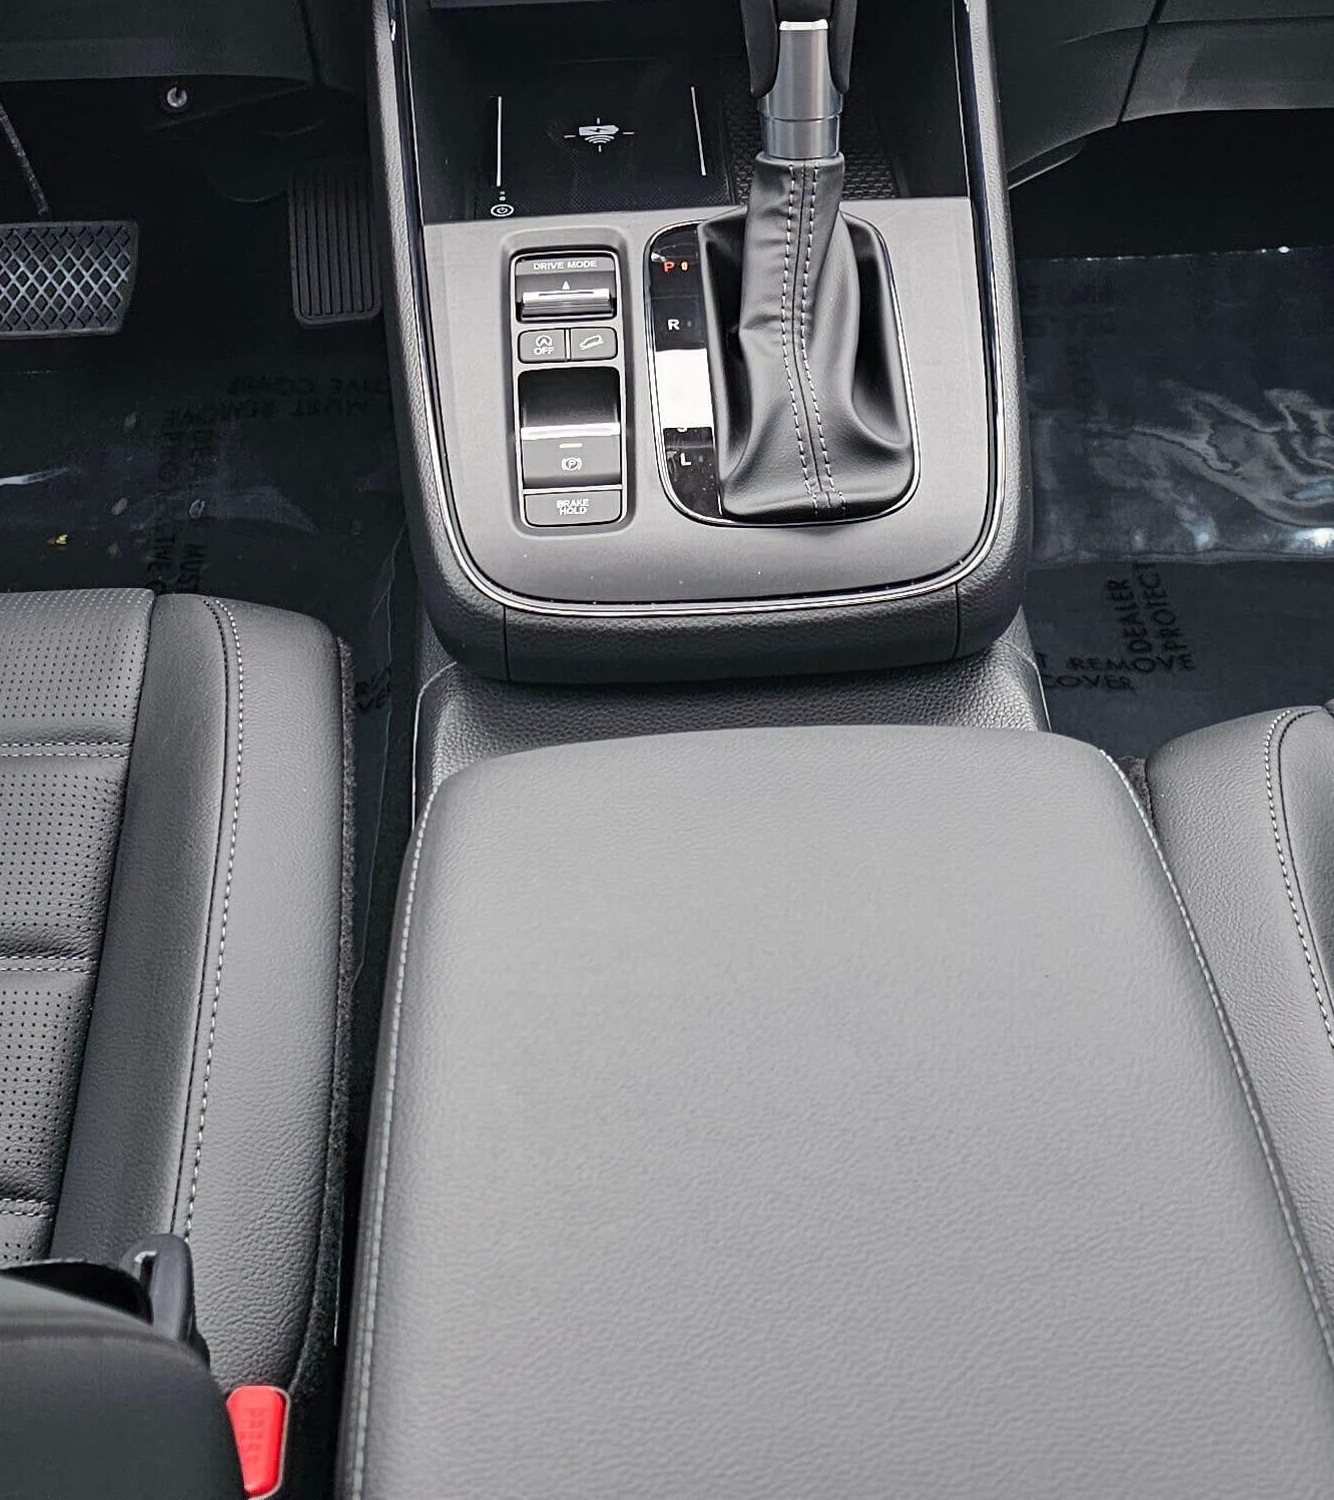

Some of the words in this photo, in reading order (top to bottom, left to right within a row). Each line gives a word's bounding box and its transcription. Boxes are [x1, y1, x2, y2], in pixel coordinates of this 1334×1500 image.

[533, 262, 564, 270] DRIVE
[567, 260, 597, 269] MODE
[663, 261, 674, 273] P
[667, 319, 680, 331] R
[533, 346, 555, 355] OFF
[680, 453, 691, 467] L
[556, 498, 589, 509] BRAKE
[559, 506, 587, 516] HOLD
